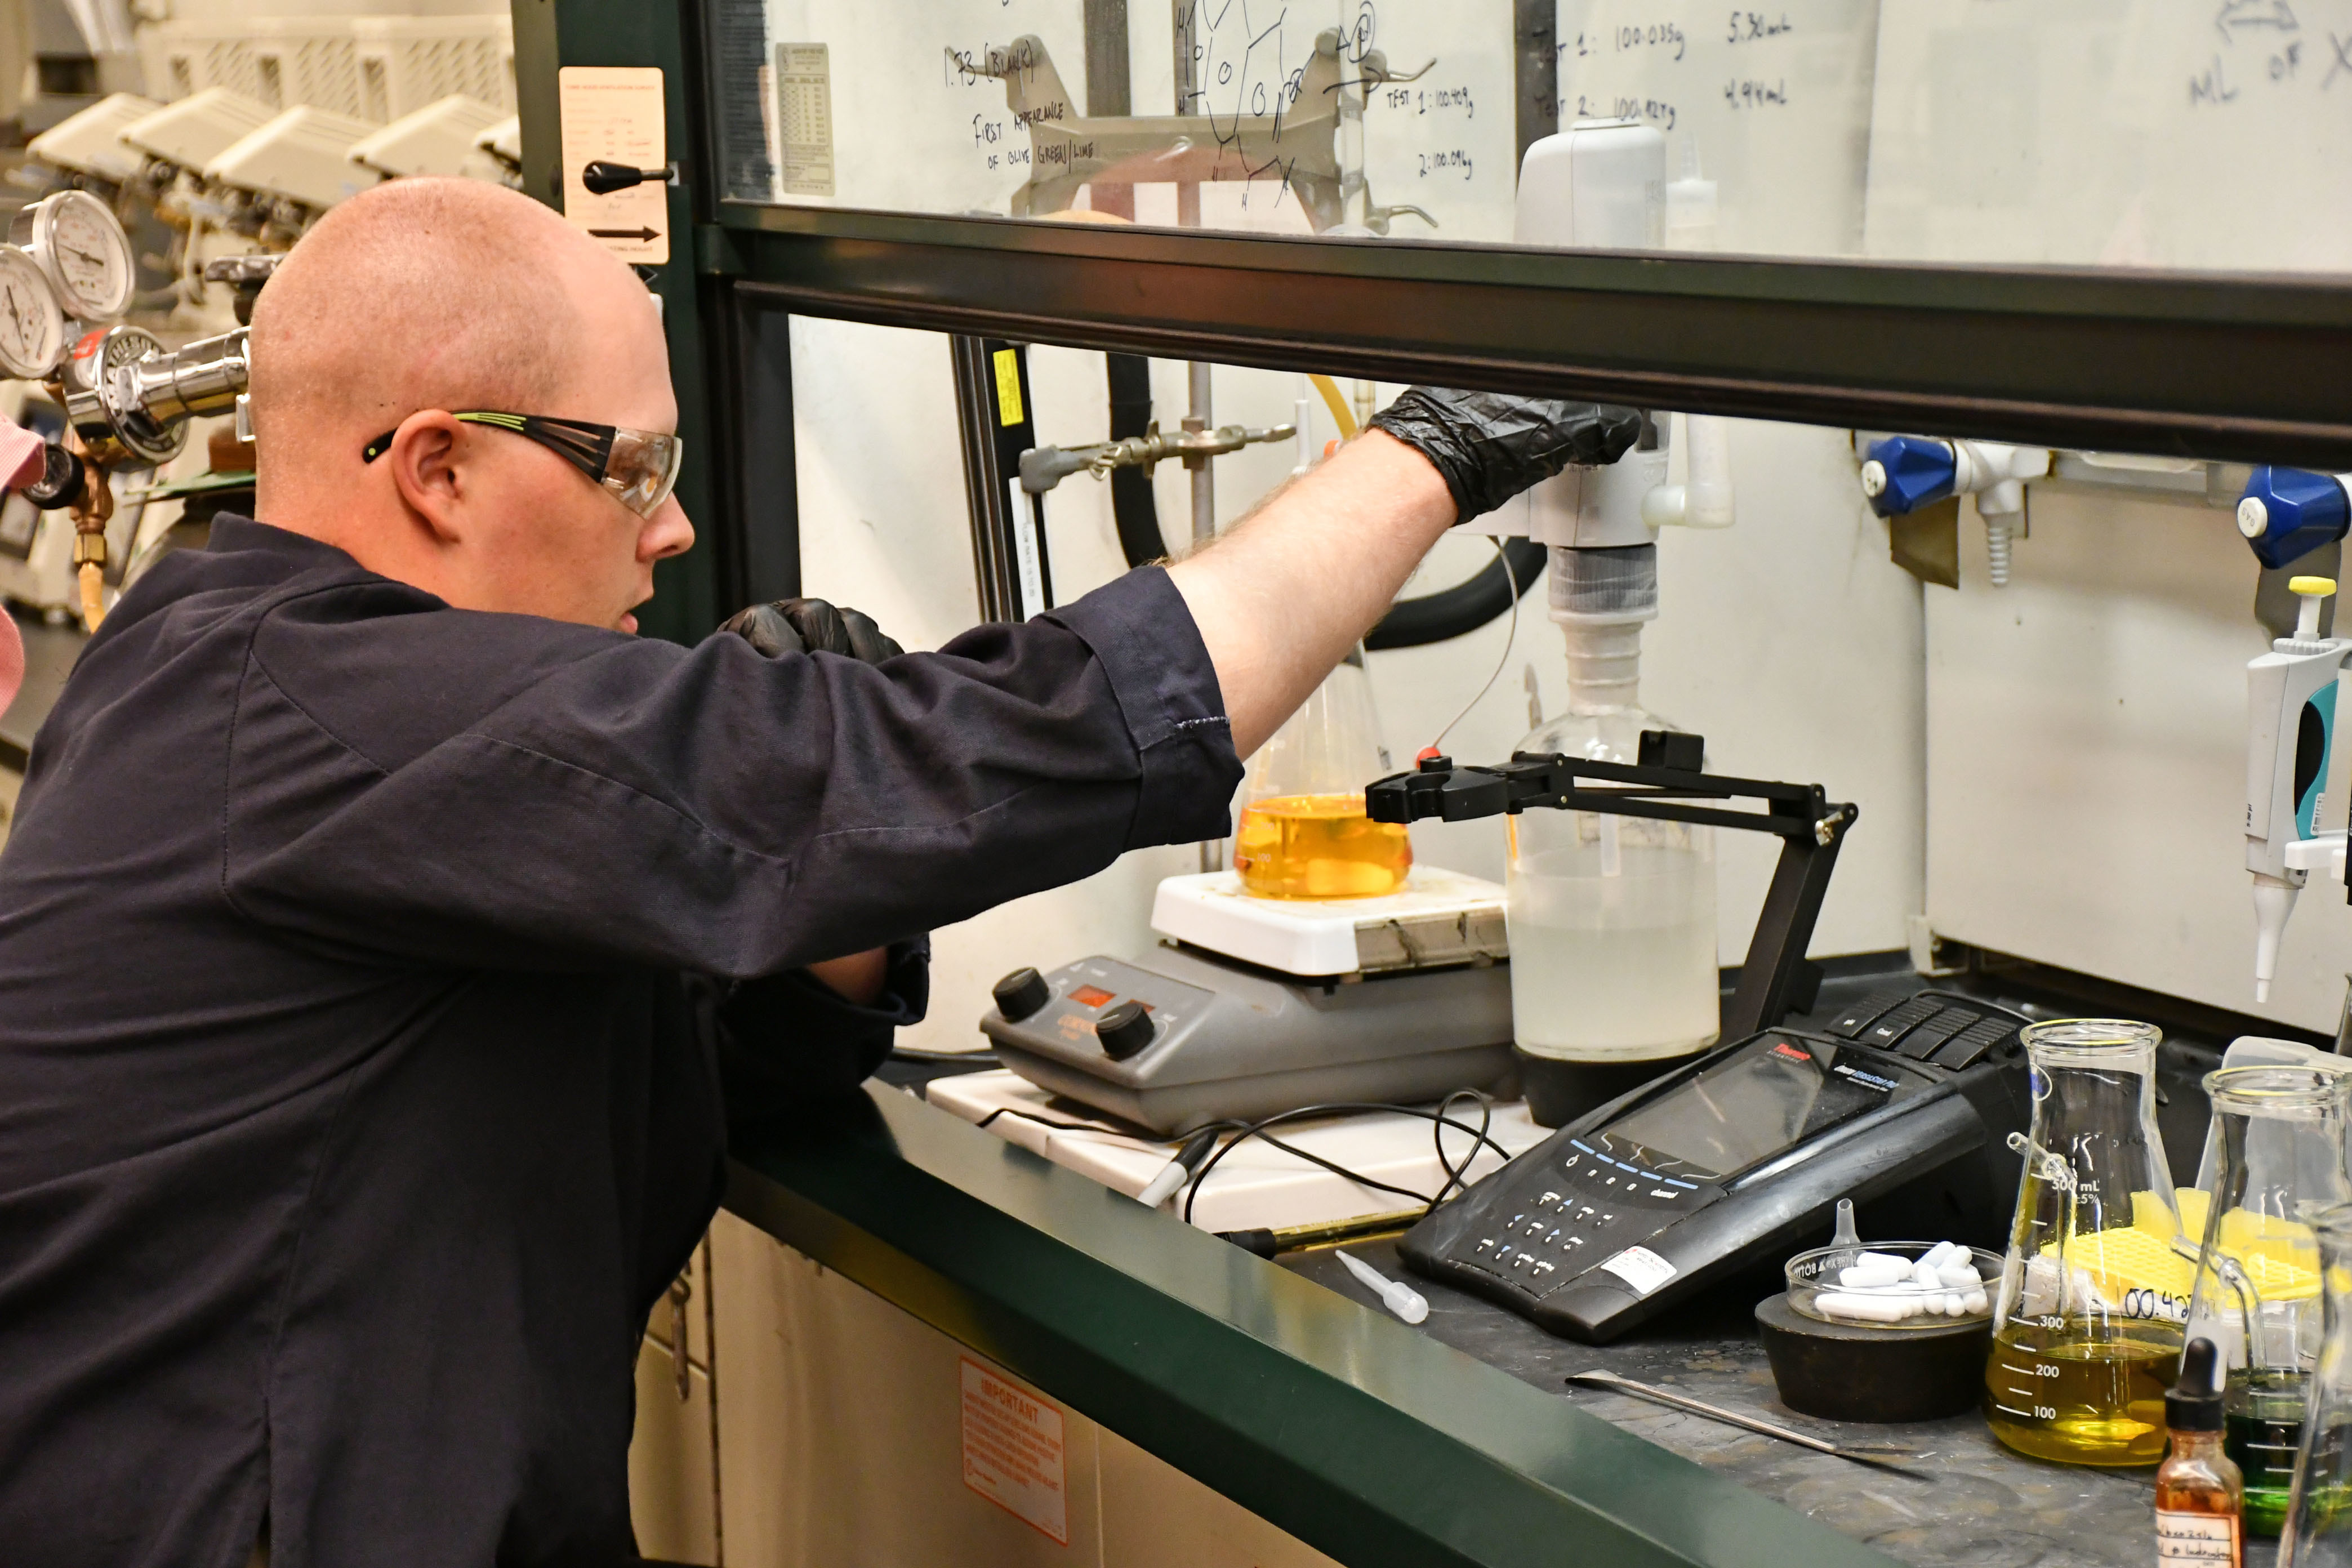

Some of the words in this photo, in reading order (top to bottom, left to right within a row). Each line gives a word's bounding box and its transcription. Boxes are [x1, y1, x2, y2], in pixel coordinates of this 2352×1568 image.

[1387, 88, 1409, 108] TEST
[973, 113, 1001, 148] FIRST
[1014, 101, 1063, 131] APPEARANCE
[988, 155, 999, 170] OF
[1008, 148, 1030, 165] OLIVE
[2080, 1180, 2100, 1191] mL
[2040, 1315, 2064, 1329] 300
[2035, 1364, 2060, 1378] 200
[2034, 1406, 2056, 1420] 100
